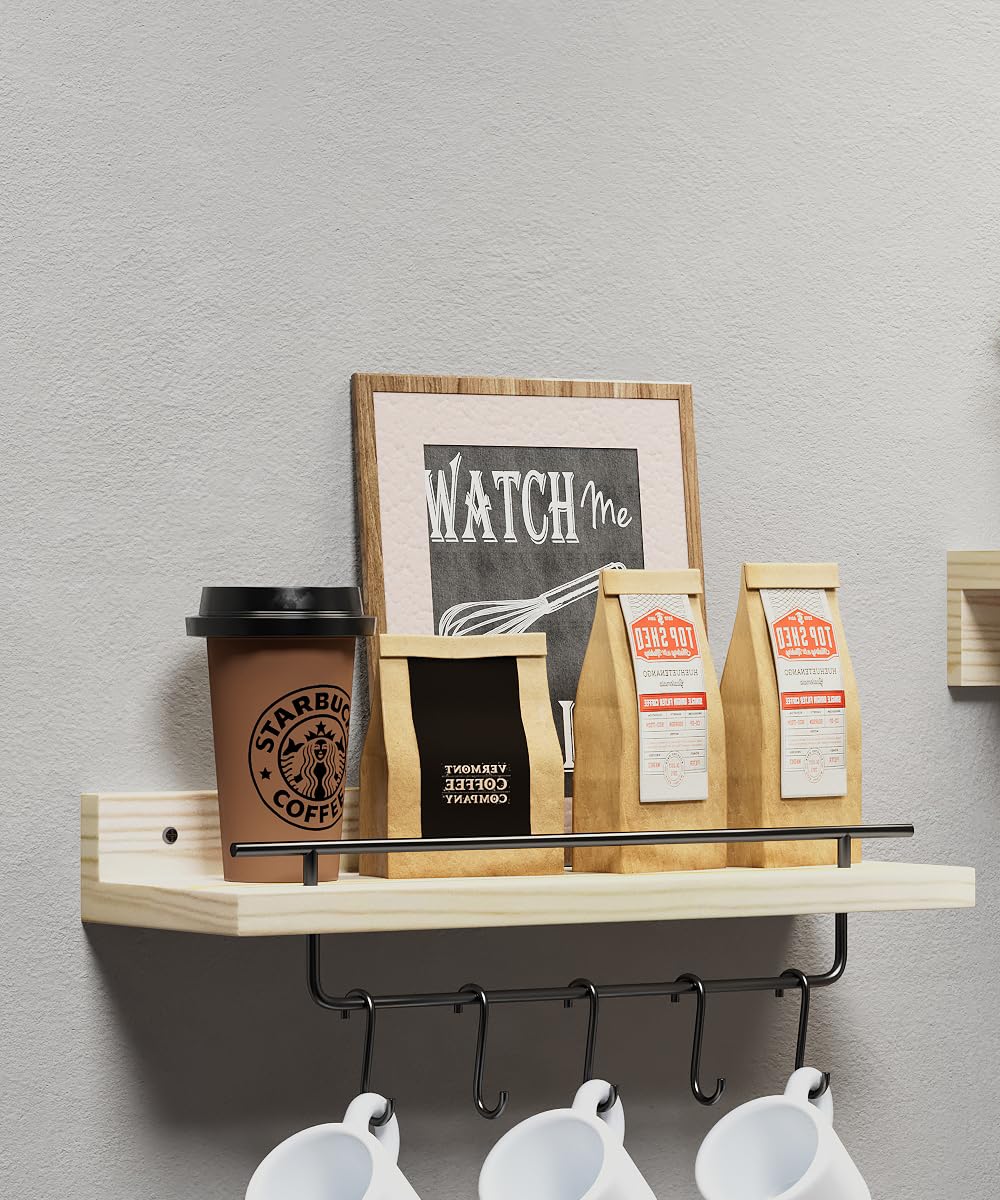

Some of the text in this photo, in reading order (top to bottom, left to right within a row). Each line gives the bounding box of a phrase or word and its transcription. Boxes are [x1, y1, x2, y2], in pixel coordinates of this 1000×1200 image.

[424, 452, 633, 545] WATCH Me
[256, 692, 350, 753] STARBUC
